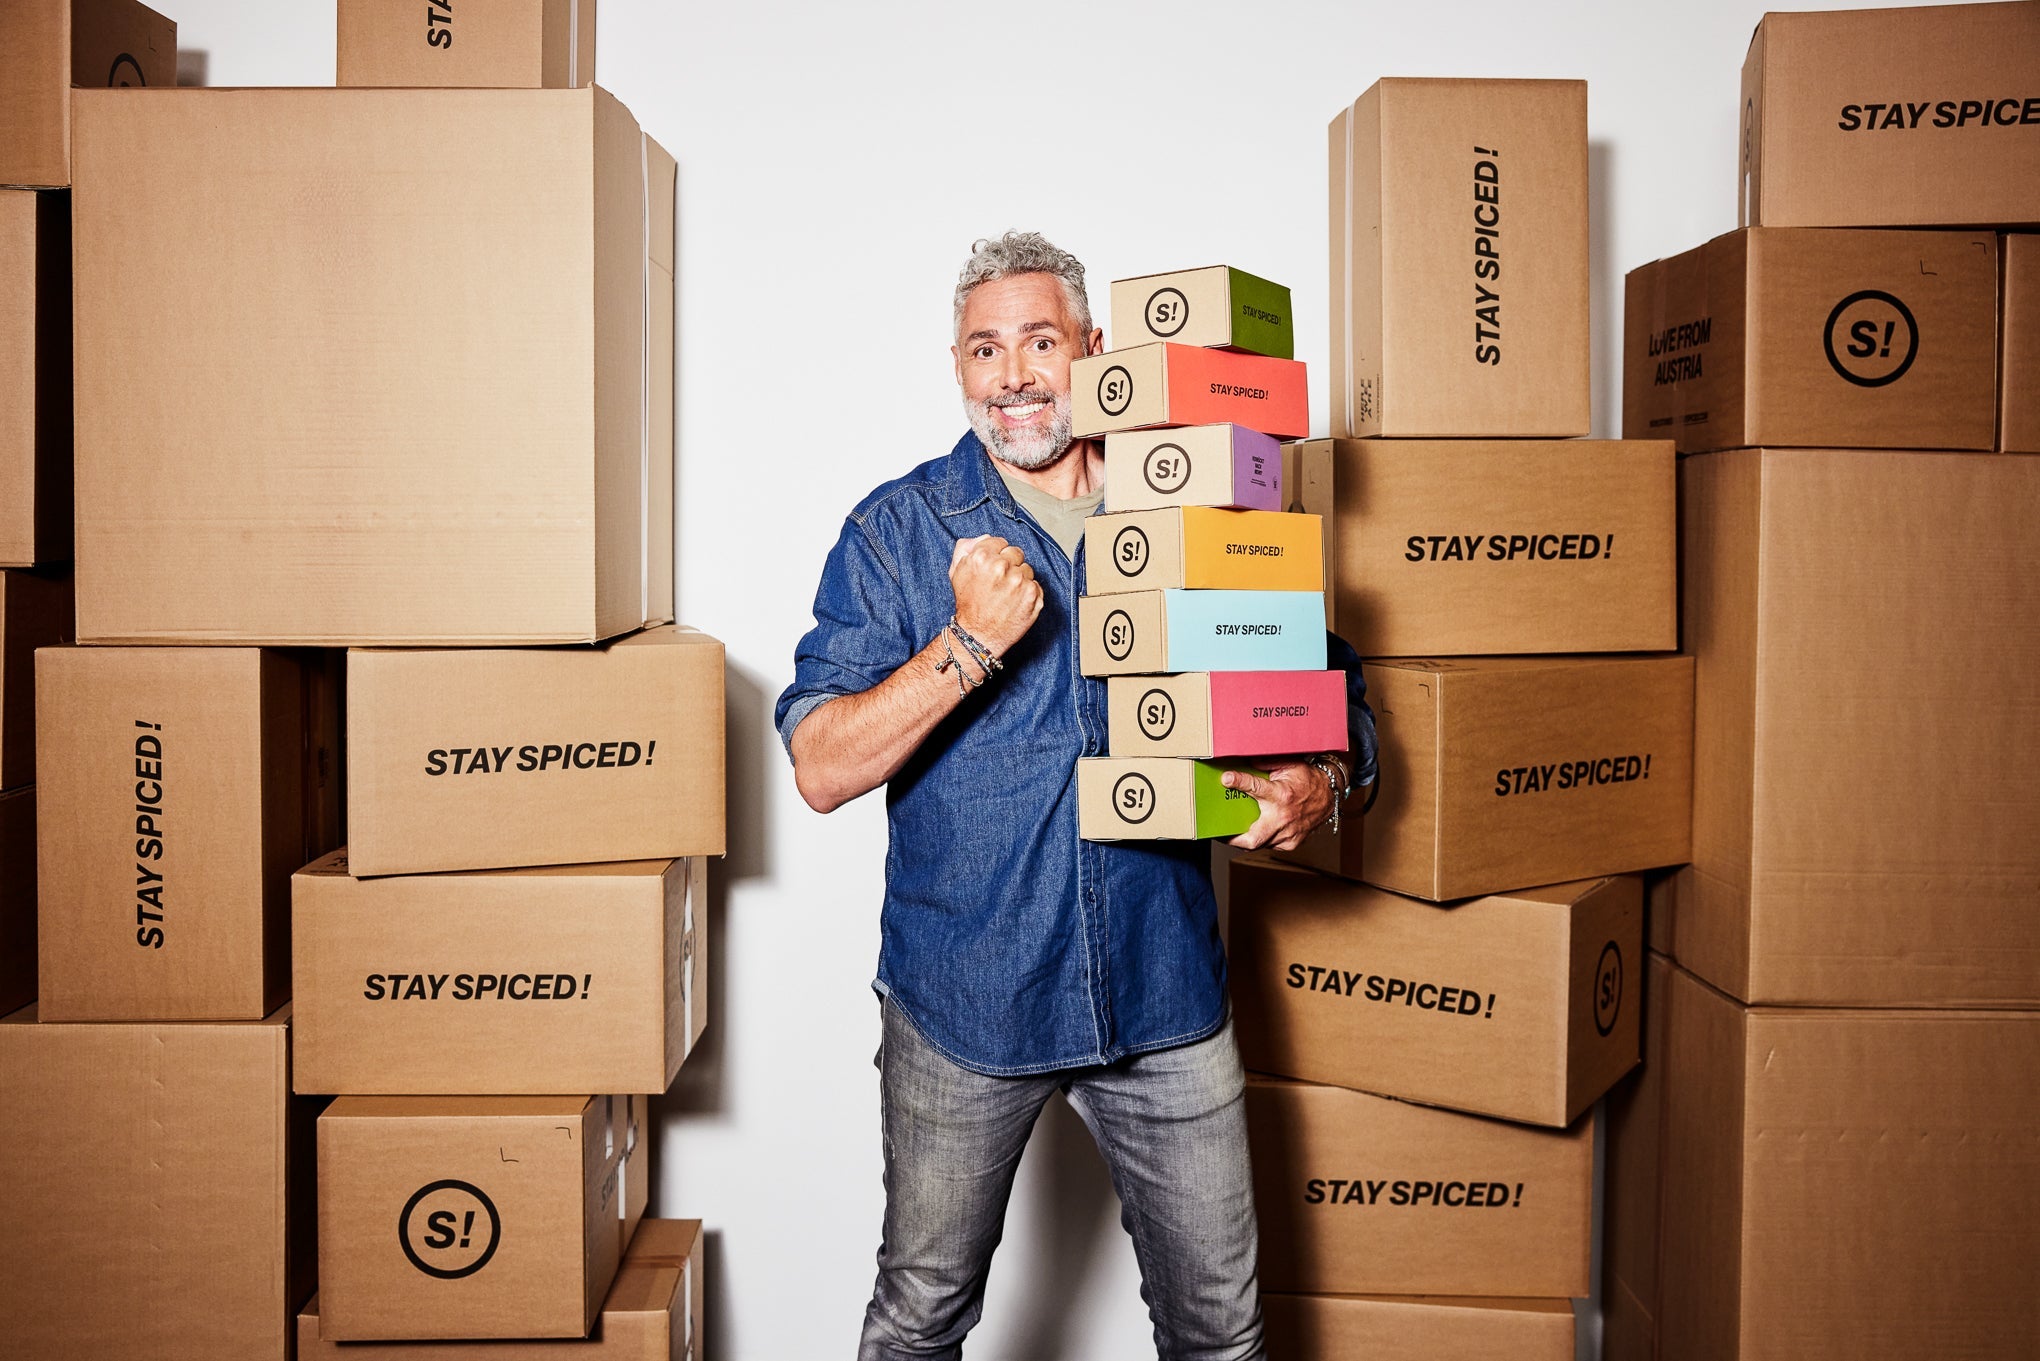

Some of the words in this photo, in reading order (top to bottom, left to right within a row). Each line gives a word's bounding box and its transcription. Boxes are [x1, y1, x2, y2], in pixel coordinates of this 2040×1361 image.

[1838, 102, 1931, 131] STAY
[1932, 97, 2040, 128] SPICE
[1473, 146, 1500, 281] SPICED!
[1155, 301, 1178, 323] S!
[1242, 304, 1257, 318] STAY
[1257, 309, 1282, 326] SPICED!
[1475, 282, 1501, 366] STAY
[1648, 326, 1677, 358] LOVE
[1677, 317, 1712, 350] FROM
[1846, 320, 1896, 358] S!
[1654, 353, 1703, 386] AUSTRIA
[1106, 379, 1124, 402] S!
[1210, 383, 1233, 395] STAY
[1232, 386, 1269, 400] SPICED!
[1155, 458, 1180, 479] S!
[1121, 541, 1141, 562] S!
[1225, 543, 1248, 555] STAY
[1248, 544, 1284, 557] SPICED!
[1404, 535, 1485, 562] STAY
[1486, 533, 1614, 561] SPICED!
[1110, 625, 1127, 646] S!
[1215, 624, 1241, 635] STAY
[1241, 624, 1283, 636] SPICED!
[1146, 704, 1166, 725] S!
[1252, 707, 1274, 718] STAY
[1274, 705, 1309, 718] SPICED!
[424, 746, 514, 776] STAY
[516, 740, 656, 773] SPICED!
[1494, 764, 1557, 797] STAY
[1557, 753, 1652, 791] SPICED!
[135, 719, 163, 861] SPICED!
[1122, 788, 1145, 809] S!
[136, 862, 165, 950] STAY
[363, 973, 450, 1001] STAY
[451, 973, 592, 1001] SPICED!
[1285, 963, 1363, 997] STAY
[1364, 975, 1496, 1019] SPICED!
[1600, 966, 1617, 1010] S!
[1305, 1179, 1387, 1205] STAY
[1389, 1180, 1524, 1208] SPICED!
[423, 1210, 474, 1250] S!
